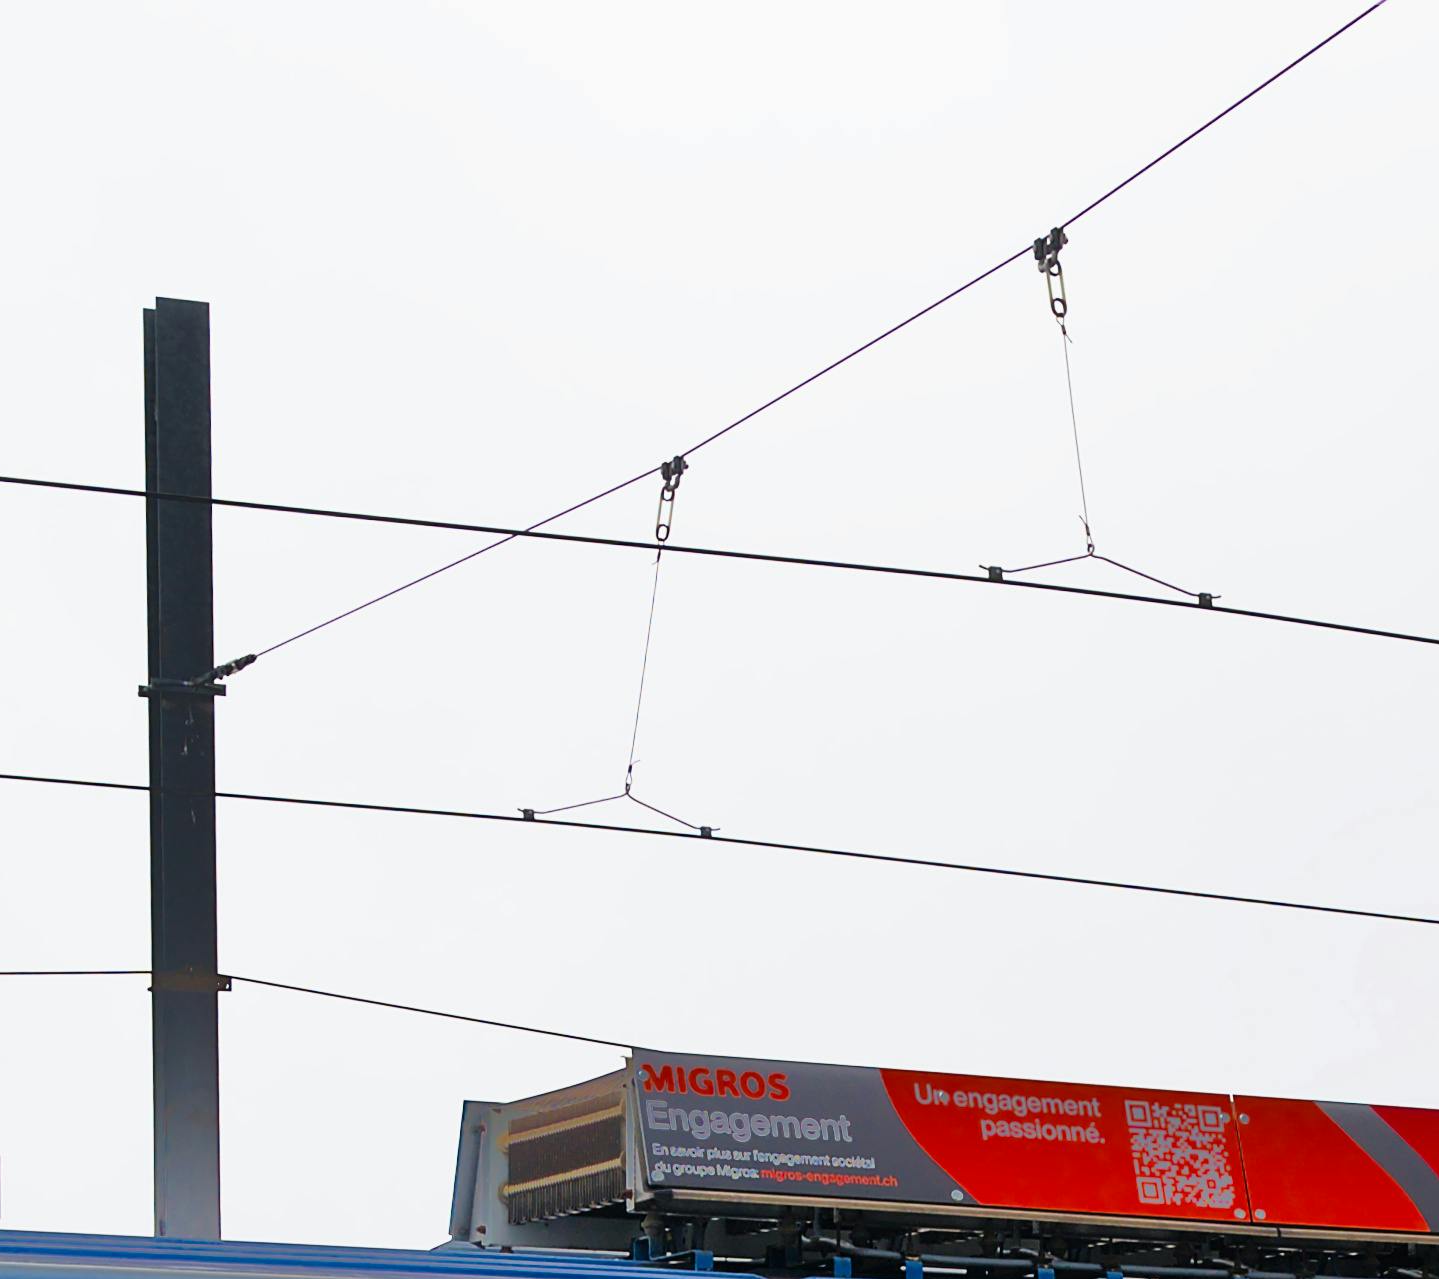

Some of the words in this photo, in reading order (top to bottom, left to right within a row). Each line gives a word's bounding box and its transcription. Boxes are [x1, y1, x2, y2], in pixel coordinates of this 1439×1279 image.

[641, 1063, 791, 1101] MIGROS
[914, 1083, 949, 1106] Un
[954, 1090, 1102, 1117] engagement
[646, 1100, 853, 1142] Engagement
[981, 1119, 1106, 1144] passionné.
[652, 1143, 669, 1155] En
[670, 1146, 704, 1158] savoir
[707, 1147, 732, 1160] plus
[733, 1150, 751, 1160] sur
[654, 1161, 671, 1173] du
[672, 1163, 715, 1177] groupe
[761, 1169, 898, 1187] migros-engagement.ch
